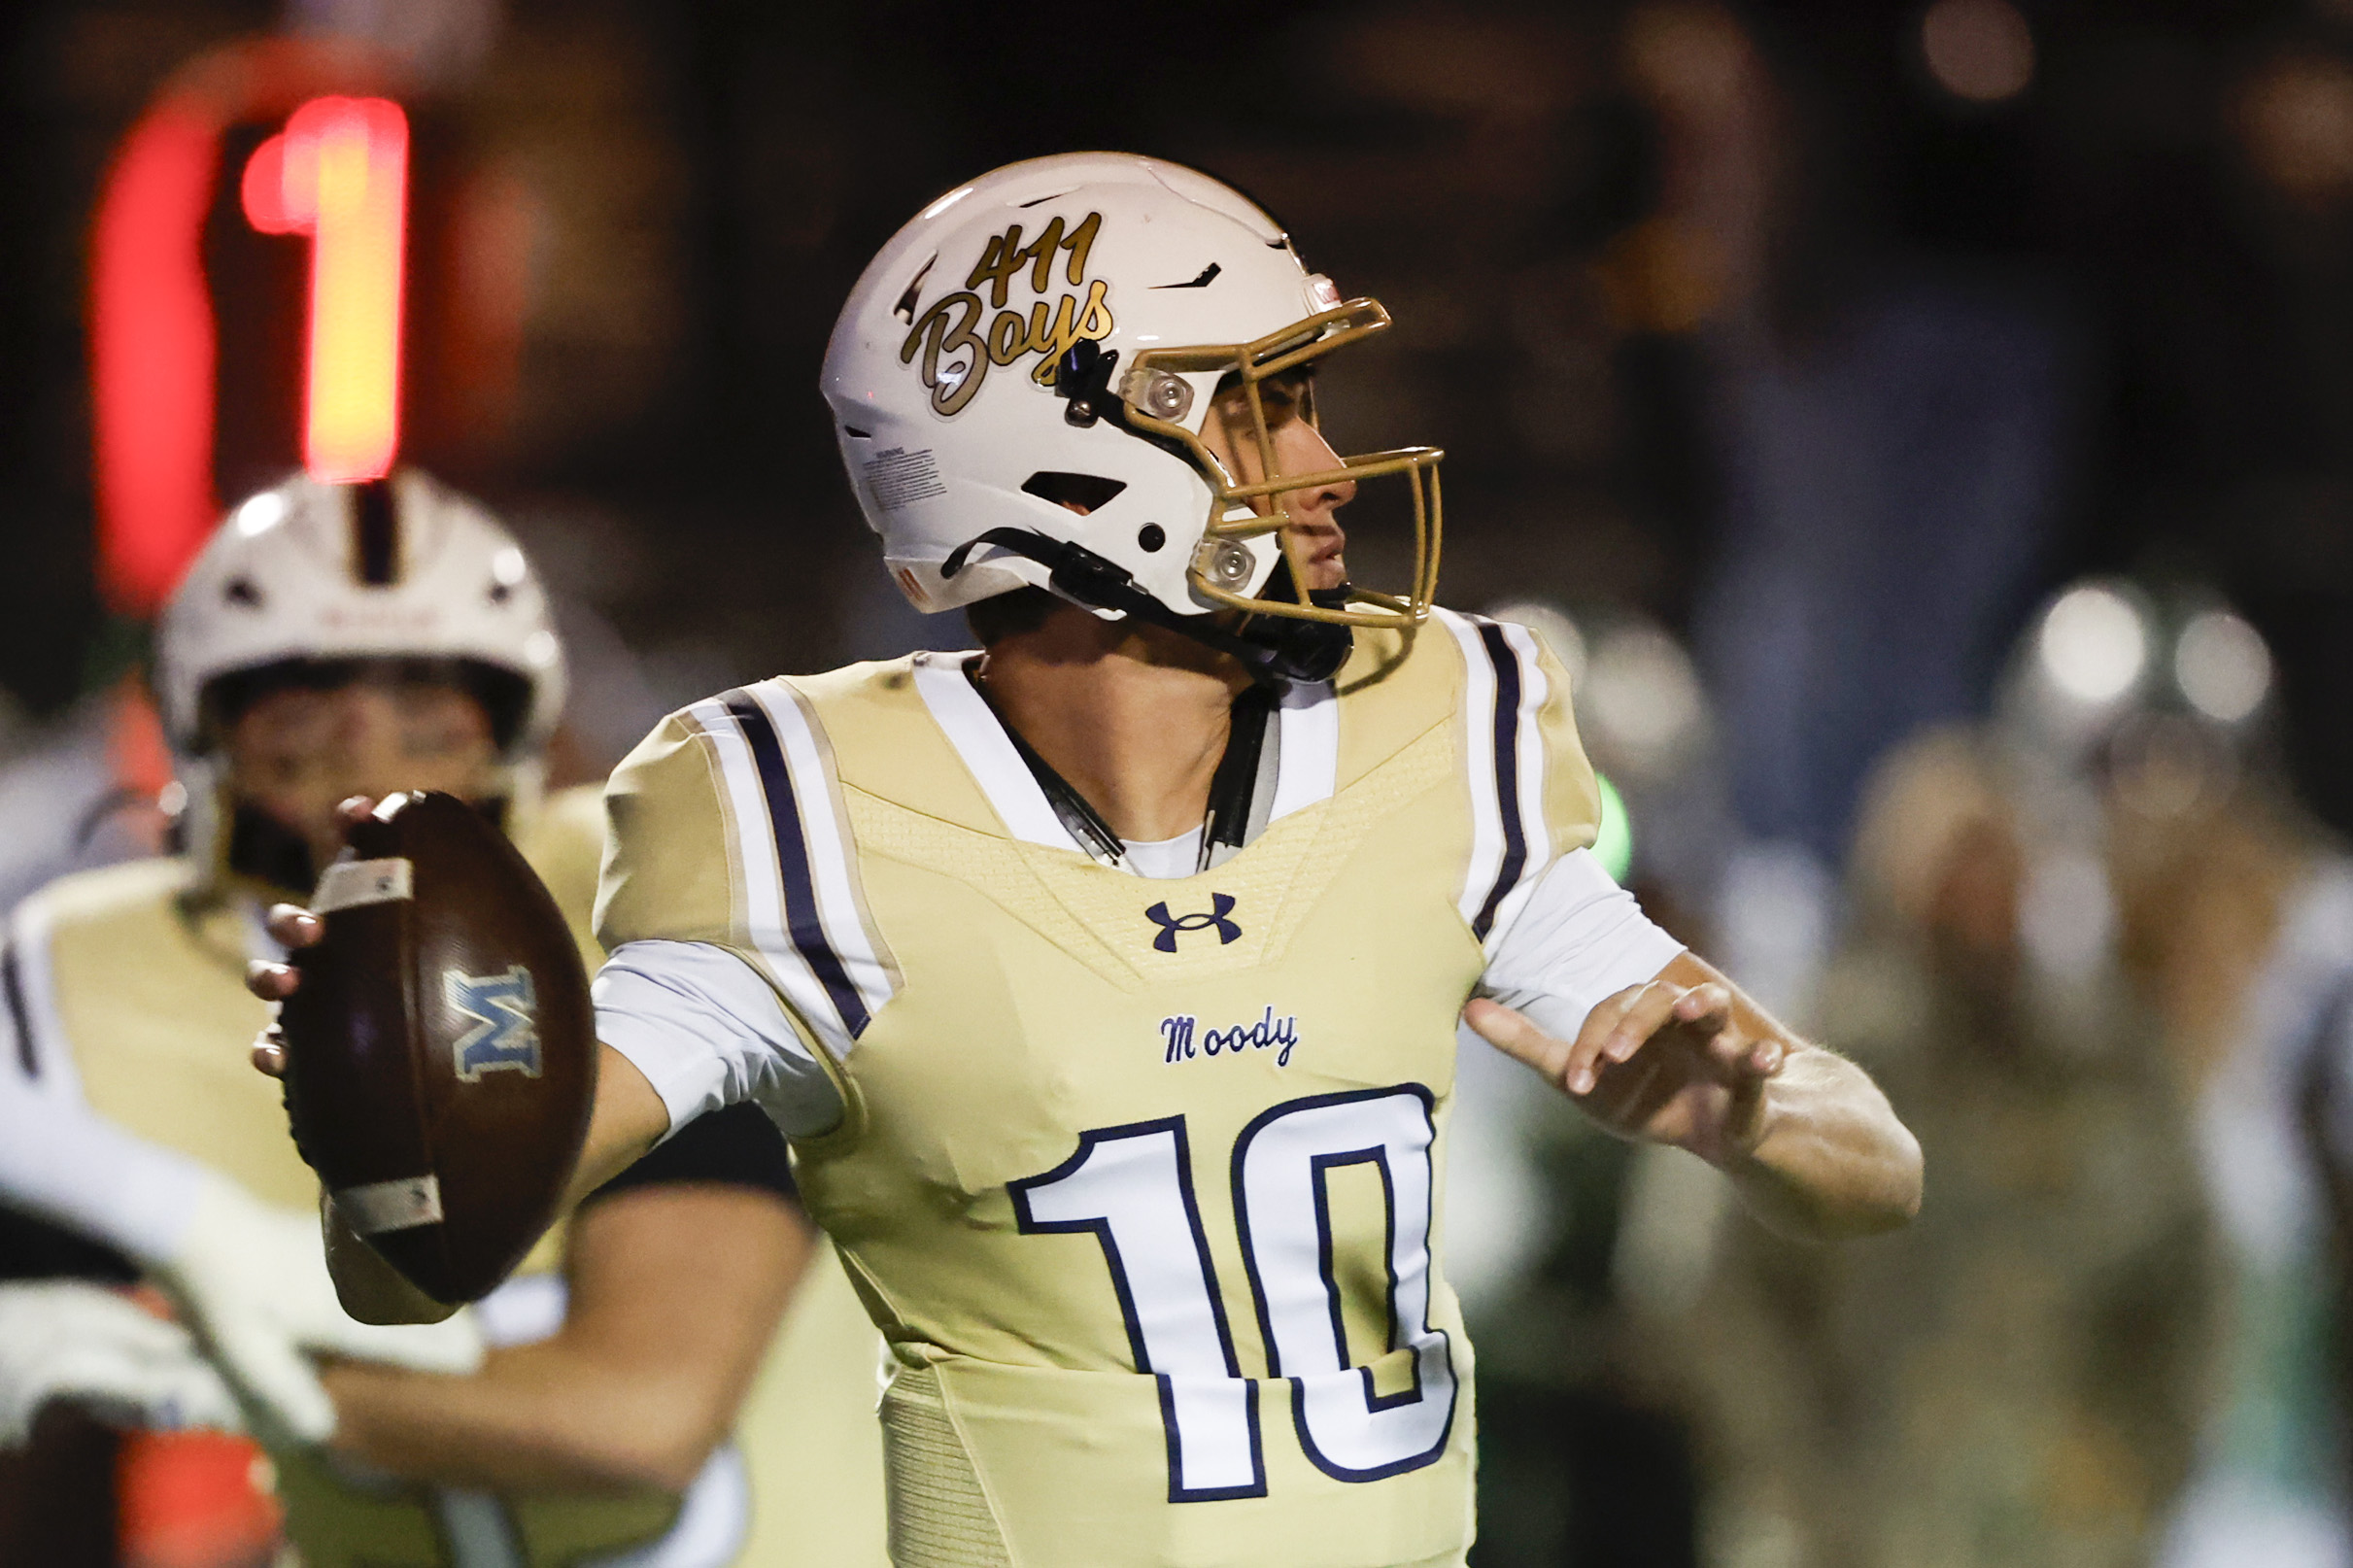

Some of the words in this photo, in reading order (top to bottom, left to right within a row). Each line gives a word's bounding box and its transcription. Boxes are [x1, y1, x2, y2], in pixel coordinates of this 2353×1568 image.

[966, 212, 1102, 309] 411
[901, 279, 1113, 416] Boys
[442, 964, 543, 1082] M
[1161, 1006, 1298, 1068] Moody
[1006, 1081, 1457, 1504] 10
